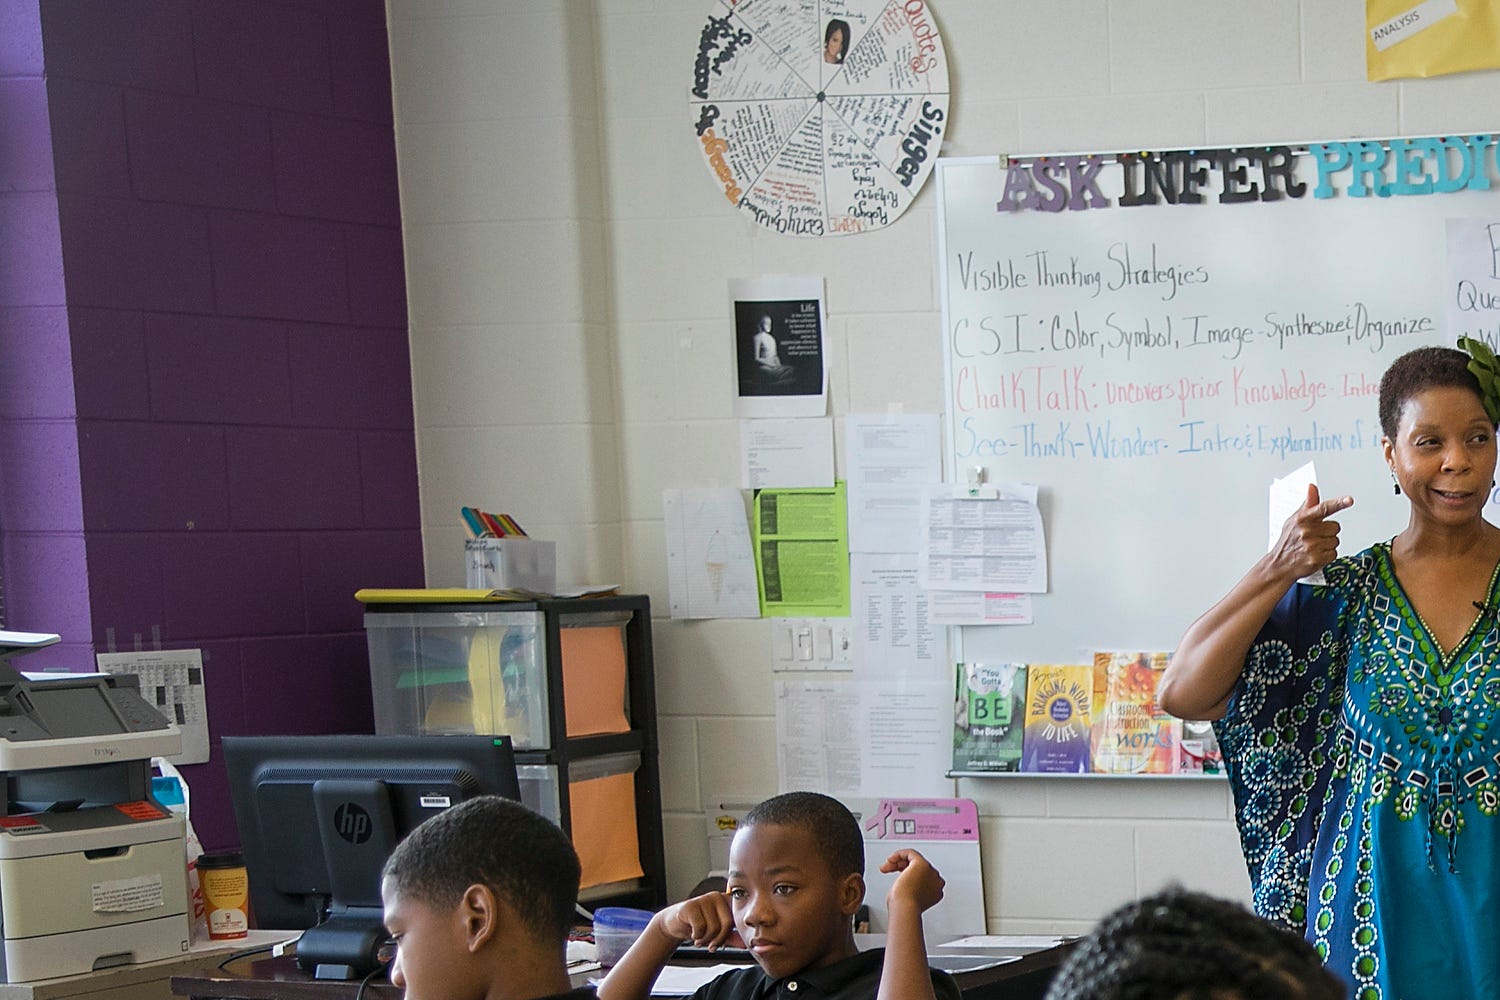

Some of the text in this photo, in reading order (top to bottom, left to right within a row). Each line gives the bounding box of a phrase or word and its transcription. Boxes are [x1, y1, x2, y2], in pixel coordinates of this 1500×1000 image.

[1373, 10, 1421, 42] ANALYSIS
[896, 101, 944, 187] Singer
[998, 153, 1111, 213] ASK
[1117, 146, 1307, 207] INFER
[958, 242, 1209, 301] Visible Thinking Strategies
[800, 303, 815, 313] Life
[1355, 302, 1436, 352] Organize
[1178, 376, 1224, 417] prior
[1178, 421, 1246, 453] Intro
[974, 698, 1007, 720] BE
[1032, 678, 1066, 716] BRINGING
[1069, 681, 1090, 716] WORDS
[1056, 723, 1078, 743] LIFE
[1117, 724, 1174, 748] works
[340, 801, 368, 844] hp
